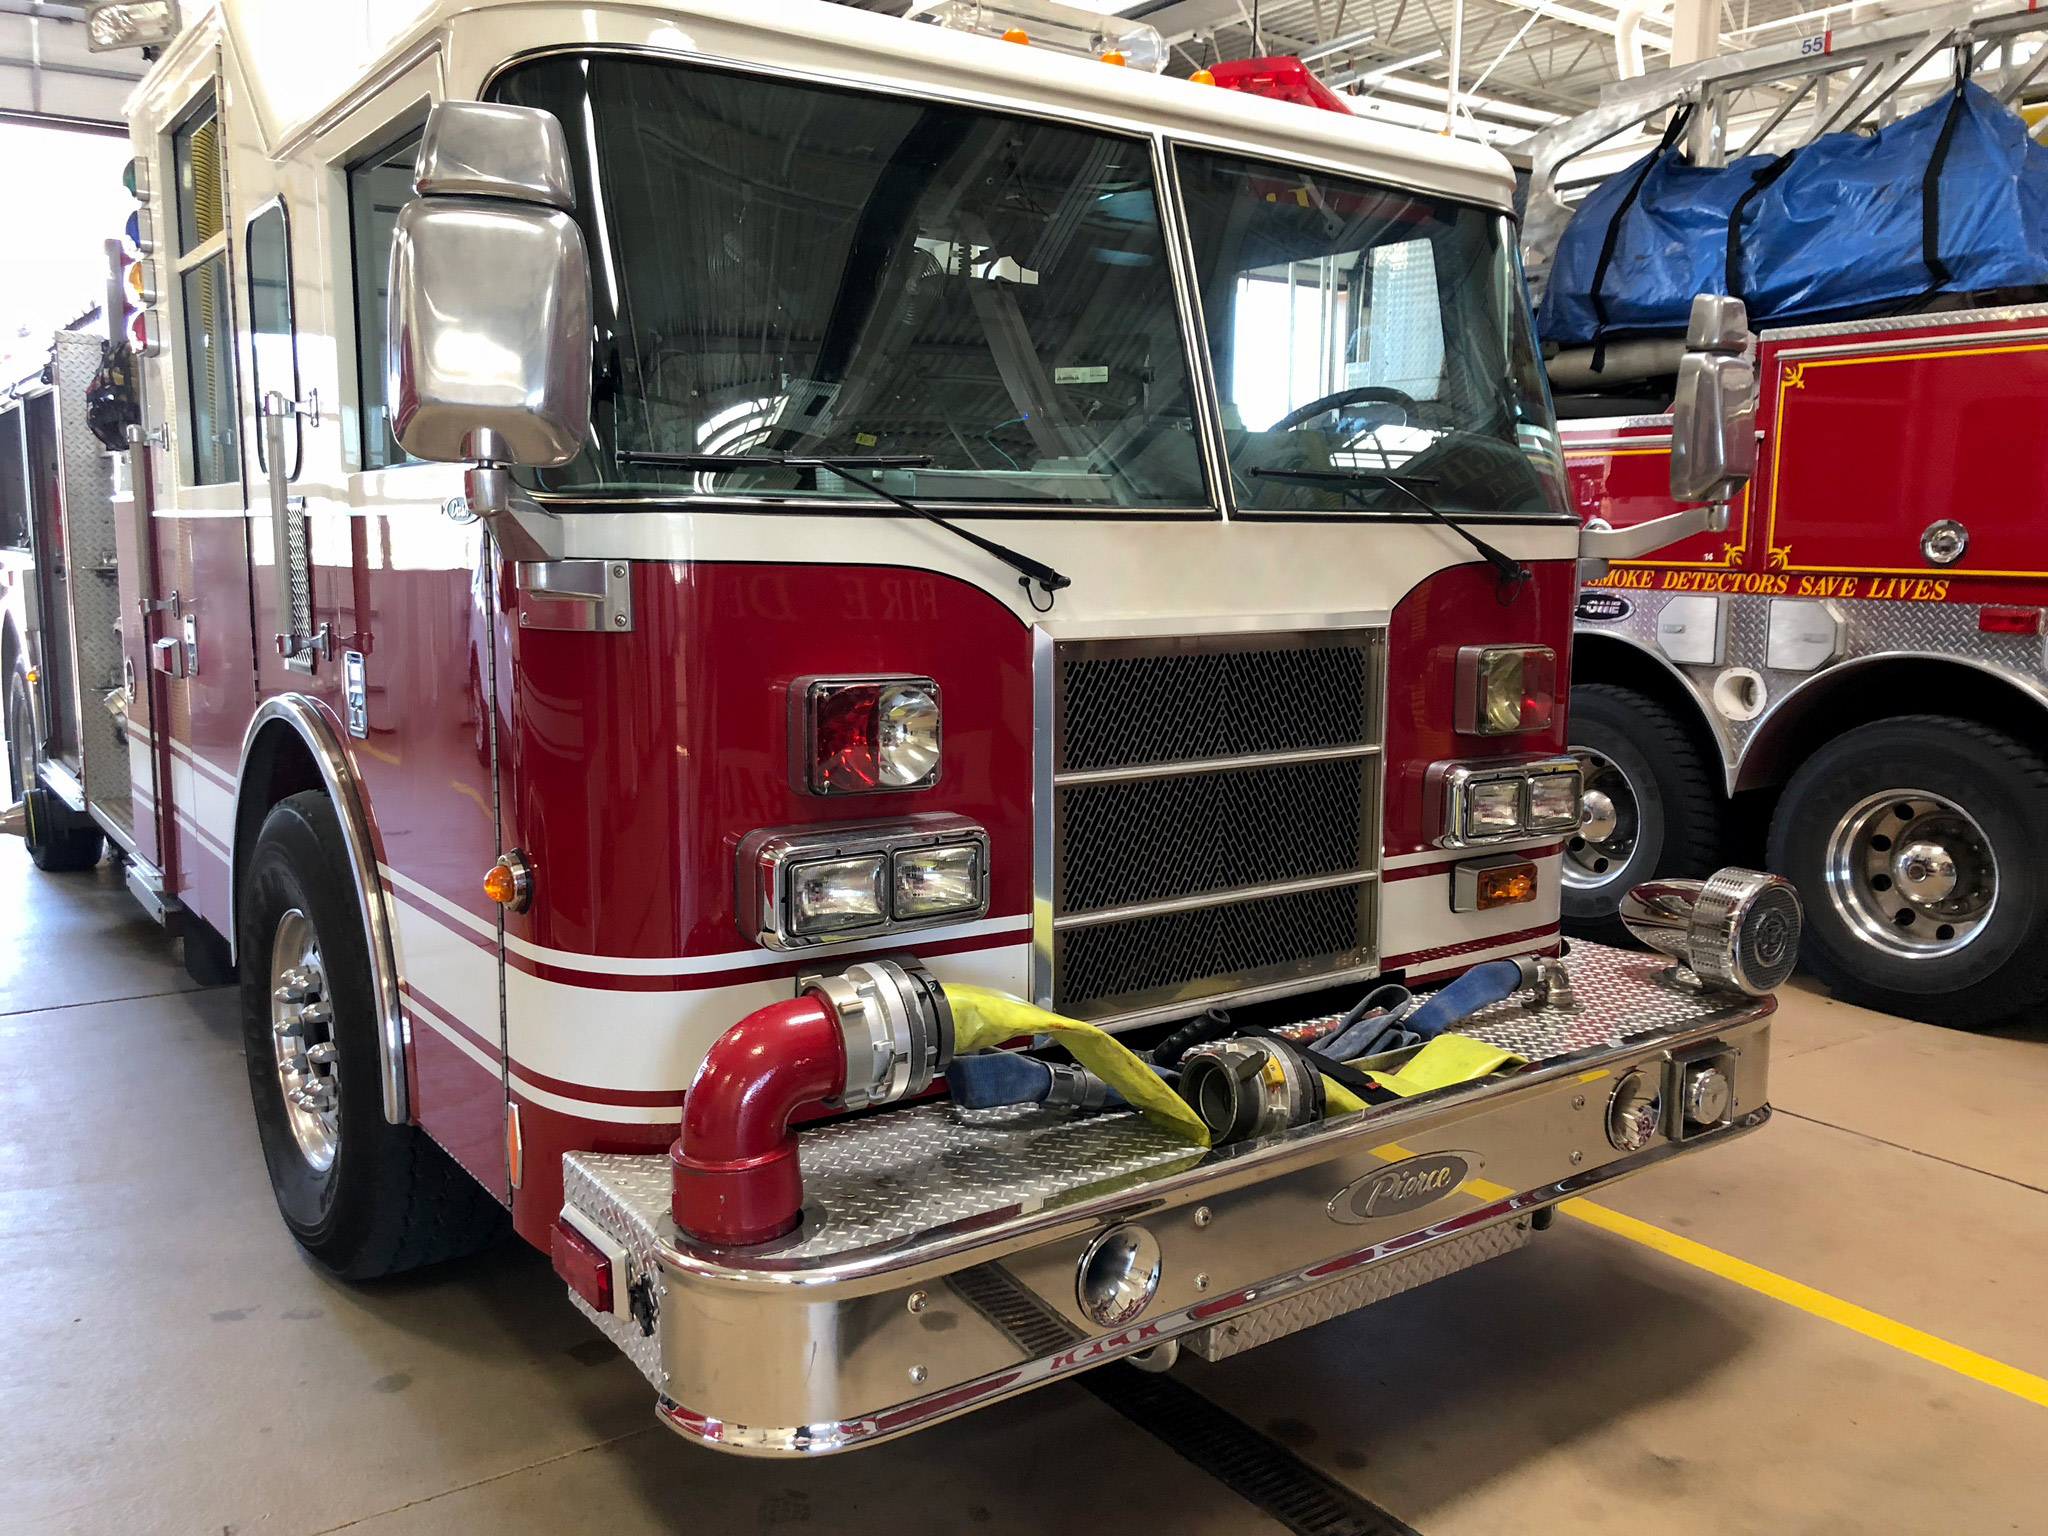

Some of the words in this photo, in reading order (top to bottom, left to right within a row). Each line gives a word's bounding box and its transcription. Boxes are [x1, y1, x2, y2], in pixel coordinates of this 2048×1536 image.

[1801, 36, 1823, 55] 55
[1662, 571, 1789, 594] DETECTORS
[1798, 574, 1858, 597] SAVE
[1867, 577, 1950, 601] LIVES
[1365, 1166, 1451, 1216] Pierce
